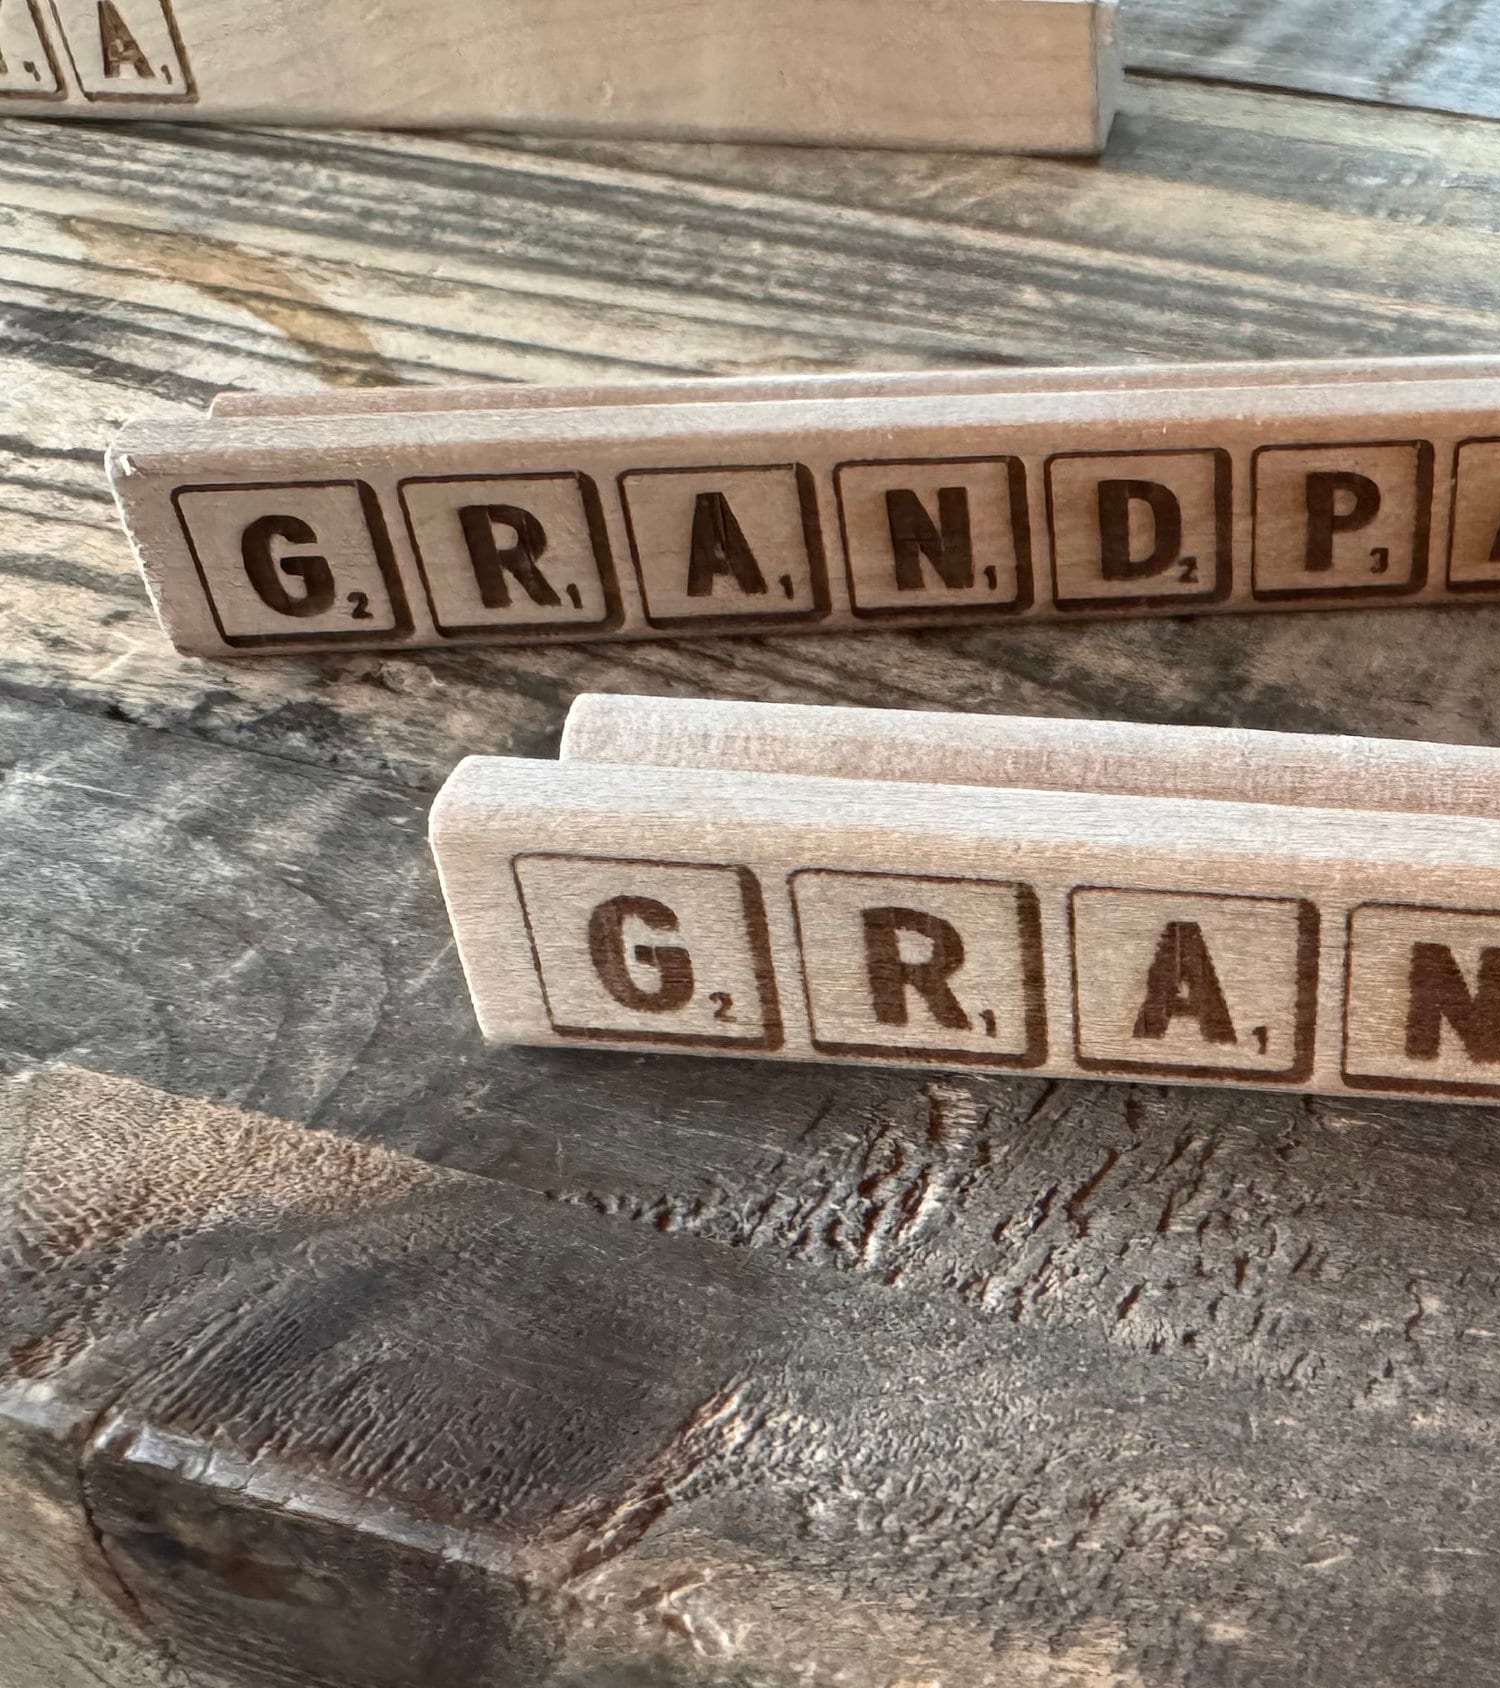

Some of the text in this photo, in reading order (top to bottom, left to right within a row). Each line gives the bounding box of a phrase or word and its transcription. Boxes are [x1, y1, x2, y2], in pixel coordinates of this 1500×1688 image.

[346, 591, 374, 618] 2
[708, 991, 734, 1023] 2
[976, 1008, 997, 1038] 1
[1251, 1025, 1269, 1055] 1
